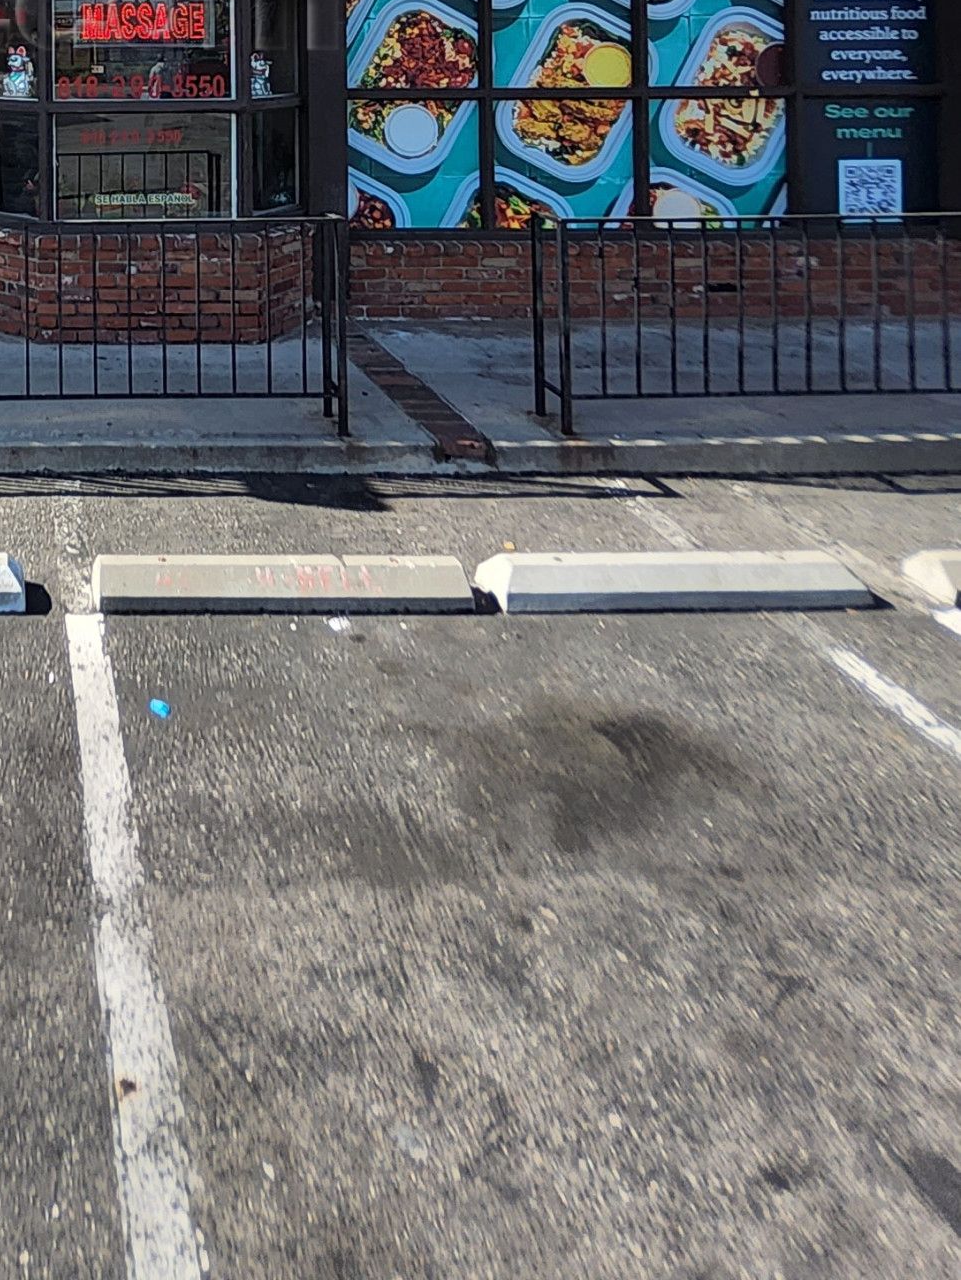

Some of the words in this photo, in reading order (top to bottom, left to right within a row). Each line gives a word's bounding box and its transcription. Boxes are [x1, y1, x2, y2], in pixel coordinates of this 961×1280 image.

[810, 7, 888, 20] nutritious
[890, 6, 927, 20] food
[79, 2, 205, 39] MASSAGE
[819, 27, 899, 40] accessible
[901, 28, 919, 40] to
[831, 48, 908, 63] everyone,
[821, 67, 918, 83] everywhere.
[825, 104, 869, 118] See
[874, 107, 914, 118] our
[836, 127, 902, 139] menu
[96, 194, 109, 204] SE
[111, 193, 146, 204] HABLA
